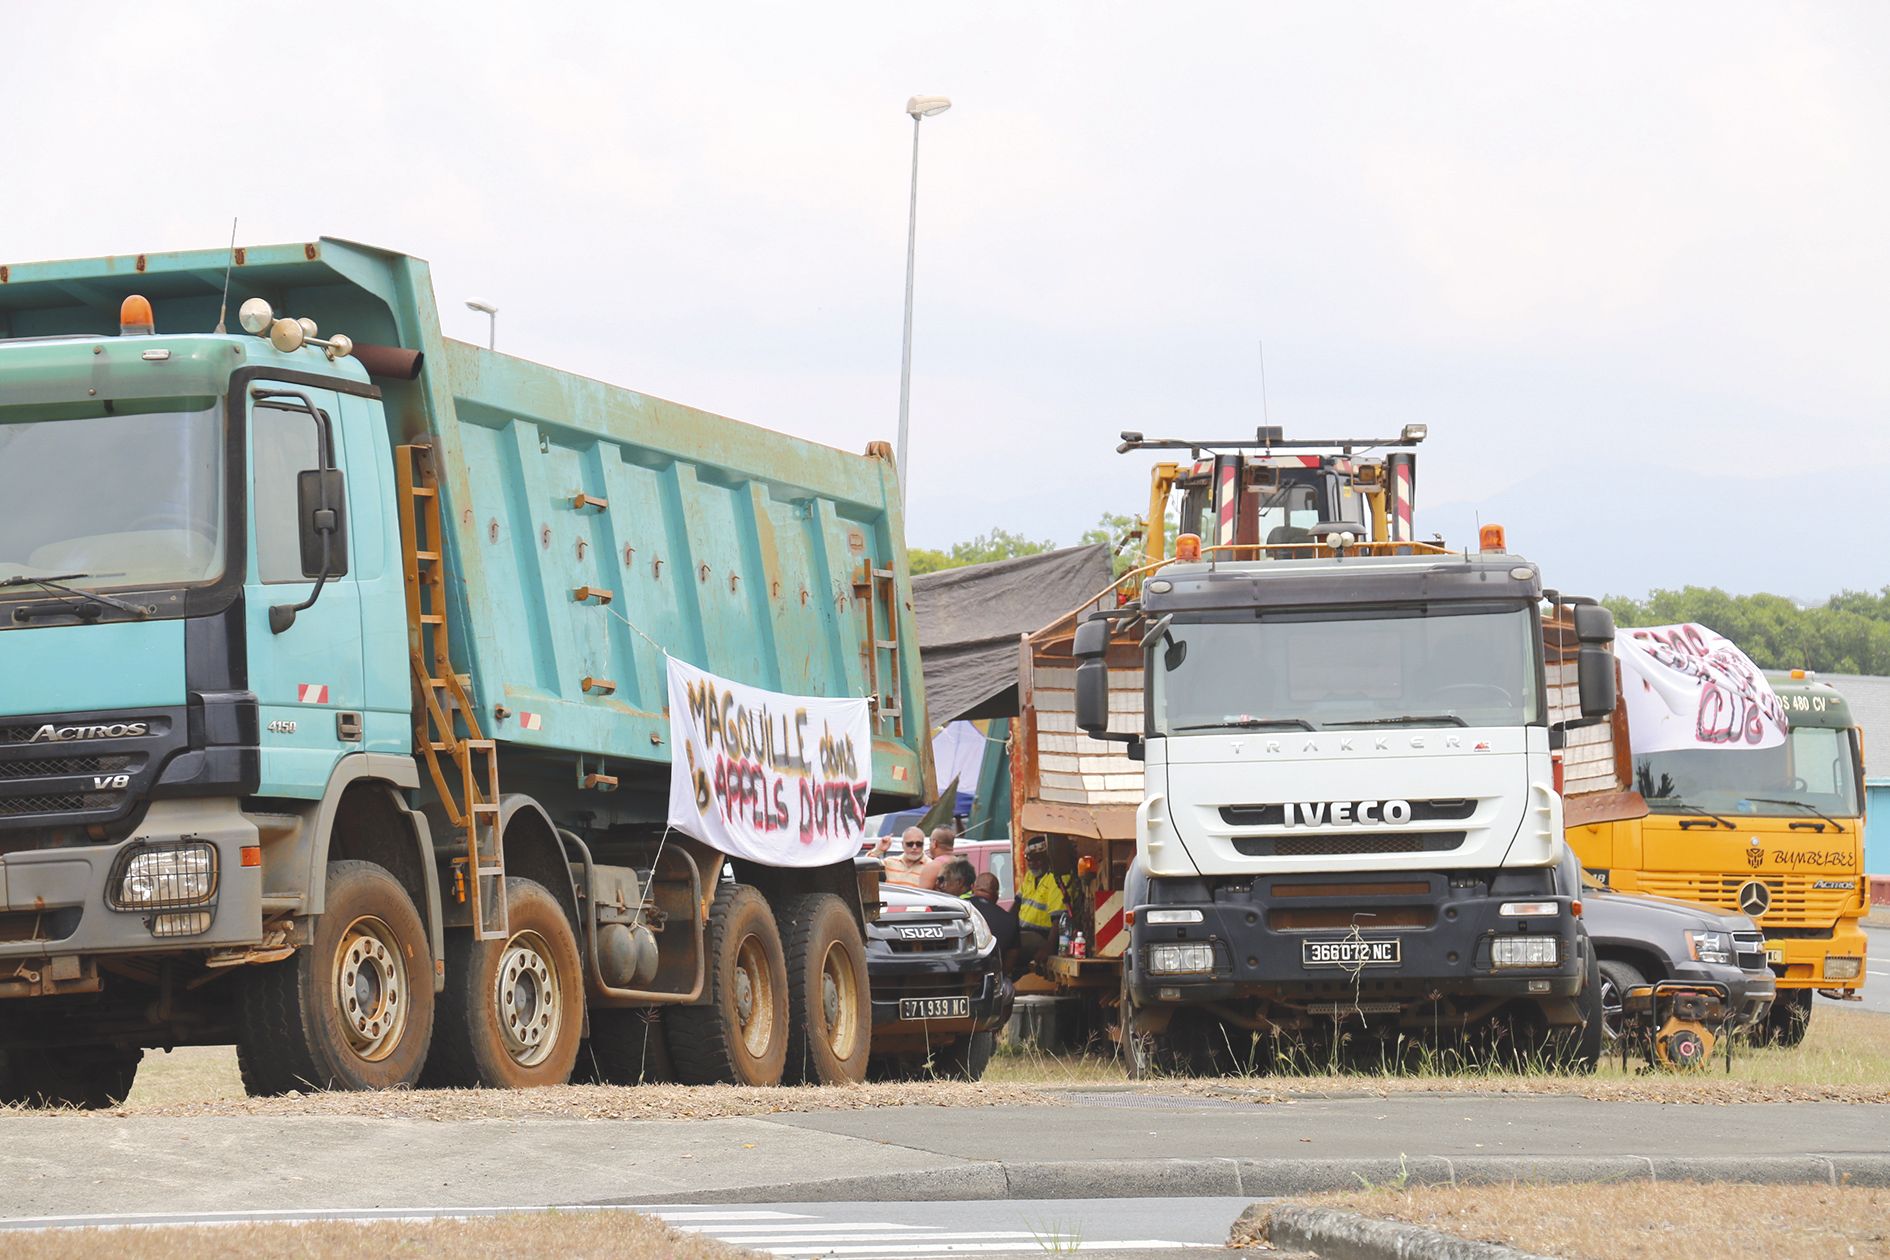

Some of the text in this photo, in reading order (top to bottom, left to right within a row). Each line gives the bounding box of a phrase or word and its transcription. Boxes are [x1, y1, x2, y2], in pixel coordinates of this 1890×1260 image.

[1793, 695, 1810, 711] 480
[1813, 696, 1826, 712] CV
[687, 678, 812, 778] MAGOUILLE
[1230, 735, 1462, 755] TRAKKER
[93, 775, 130, 790] V8
[1283, 799, 1412, 828] IVECO
[901, 926, 944, 939] ISUZU
[1373, 943, 1392, 960] NC
[952, 999, 967, 1015] NC
